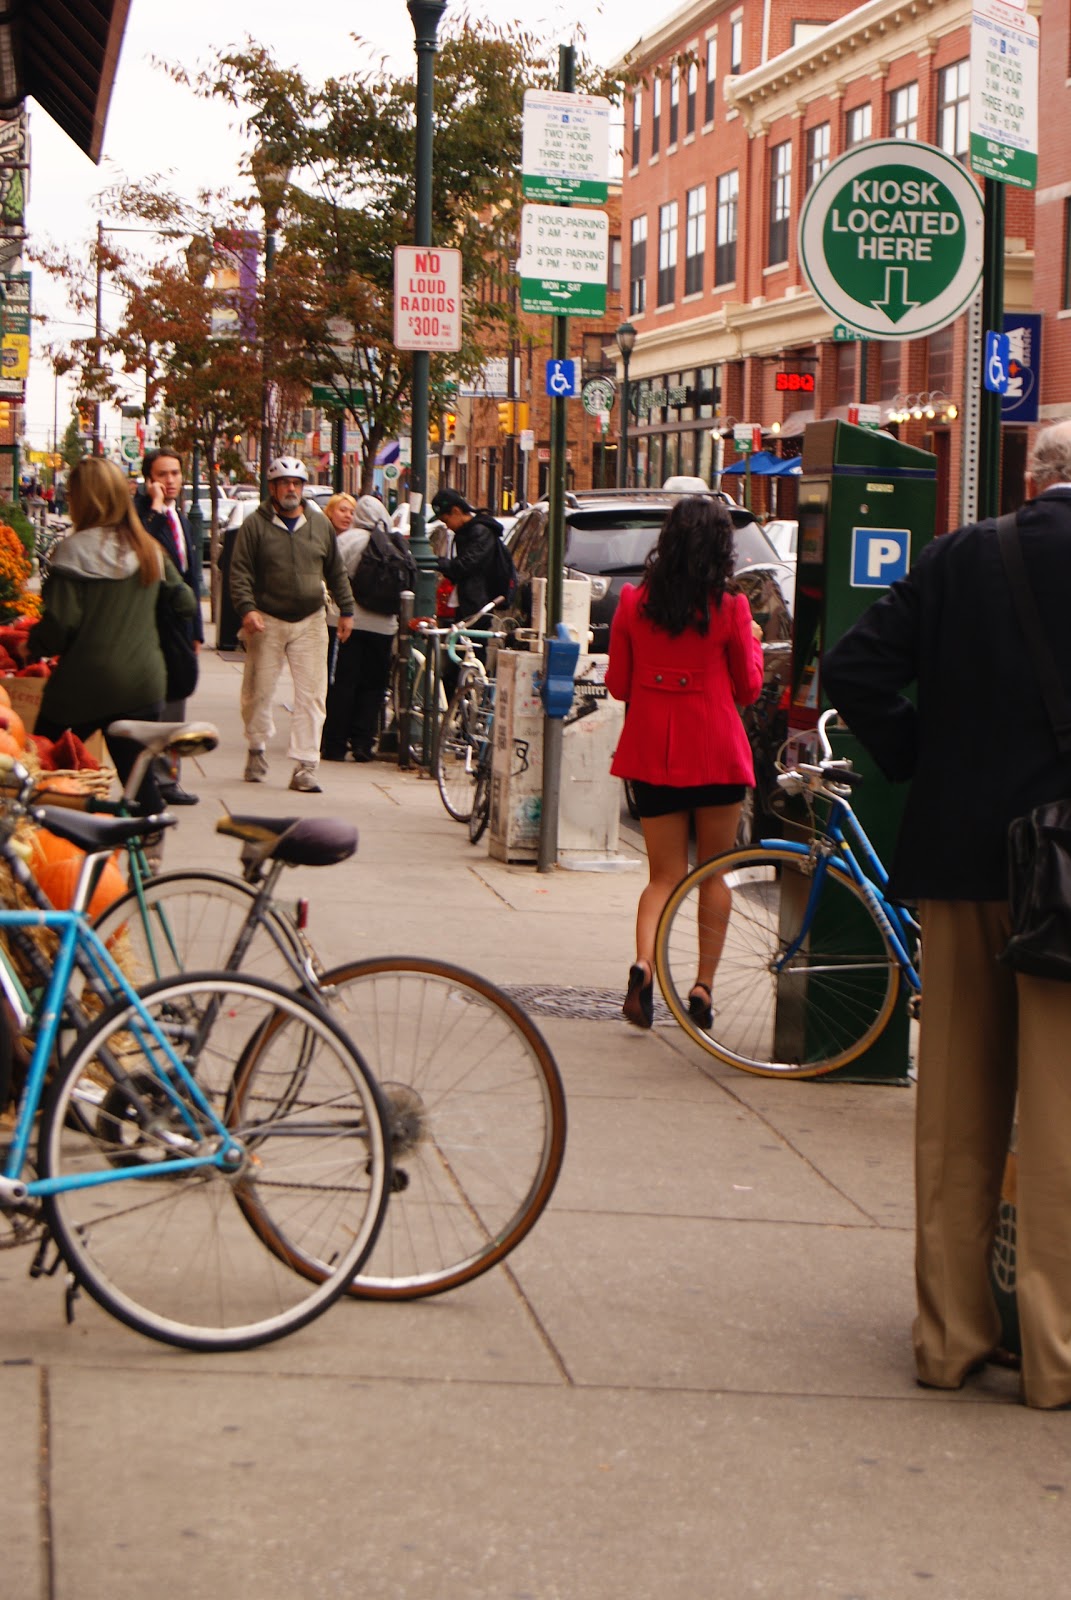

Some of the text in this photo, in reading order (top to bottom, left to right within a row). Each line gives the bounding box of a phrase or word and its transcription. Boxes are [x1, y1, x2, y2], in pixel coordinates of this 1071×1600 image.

[1003, 67, 1022, 84] HOUR
[1005, 102, 1024, 120] HOUR
[544, 128, 591, 141] TWO HOUR
[577, 142, 588, 150] PM
[539, 148, 593, 162] THREE HOUR
[578, 163, 588, 171] PM
[568, 179, 581, 188] SAT
[852, 179, 940, 206] KIOSK
[526, 212, 606, 230] 2 HOUR PARKING
[831, 208, 960, 236] LOCATED
[538, 226, 544, 236] 9
[548, 228, 560, 238] AM
[573, 230, 579, 239] 4
[583, 231, 596, 240] PM
[526, 244, 605, 261] 3 HOUR PARKING
[857, 237, 933, 262] HERE
[415, 253, 440, 274] NO
[537, 258, 543, 266] 4
[547, 258, 560, 268] PM
[572, 261, 582, 271] 10
[585, 261, 598, 272] PM
[409, 278, 446, 295] LOUD
[541, 280, 560, 290] MON
[567, 282, 582, 292] SAT
[401, 296, 456, 313] RADIOS
[408, 316, 439, 337] $300
[1022, 327, 1032, 368] BANK
[867, 538, 901, 578] P
[574, 683, 606, 697] quirer
